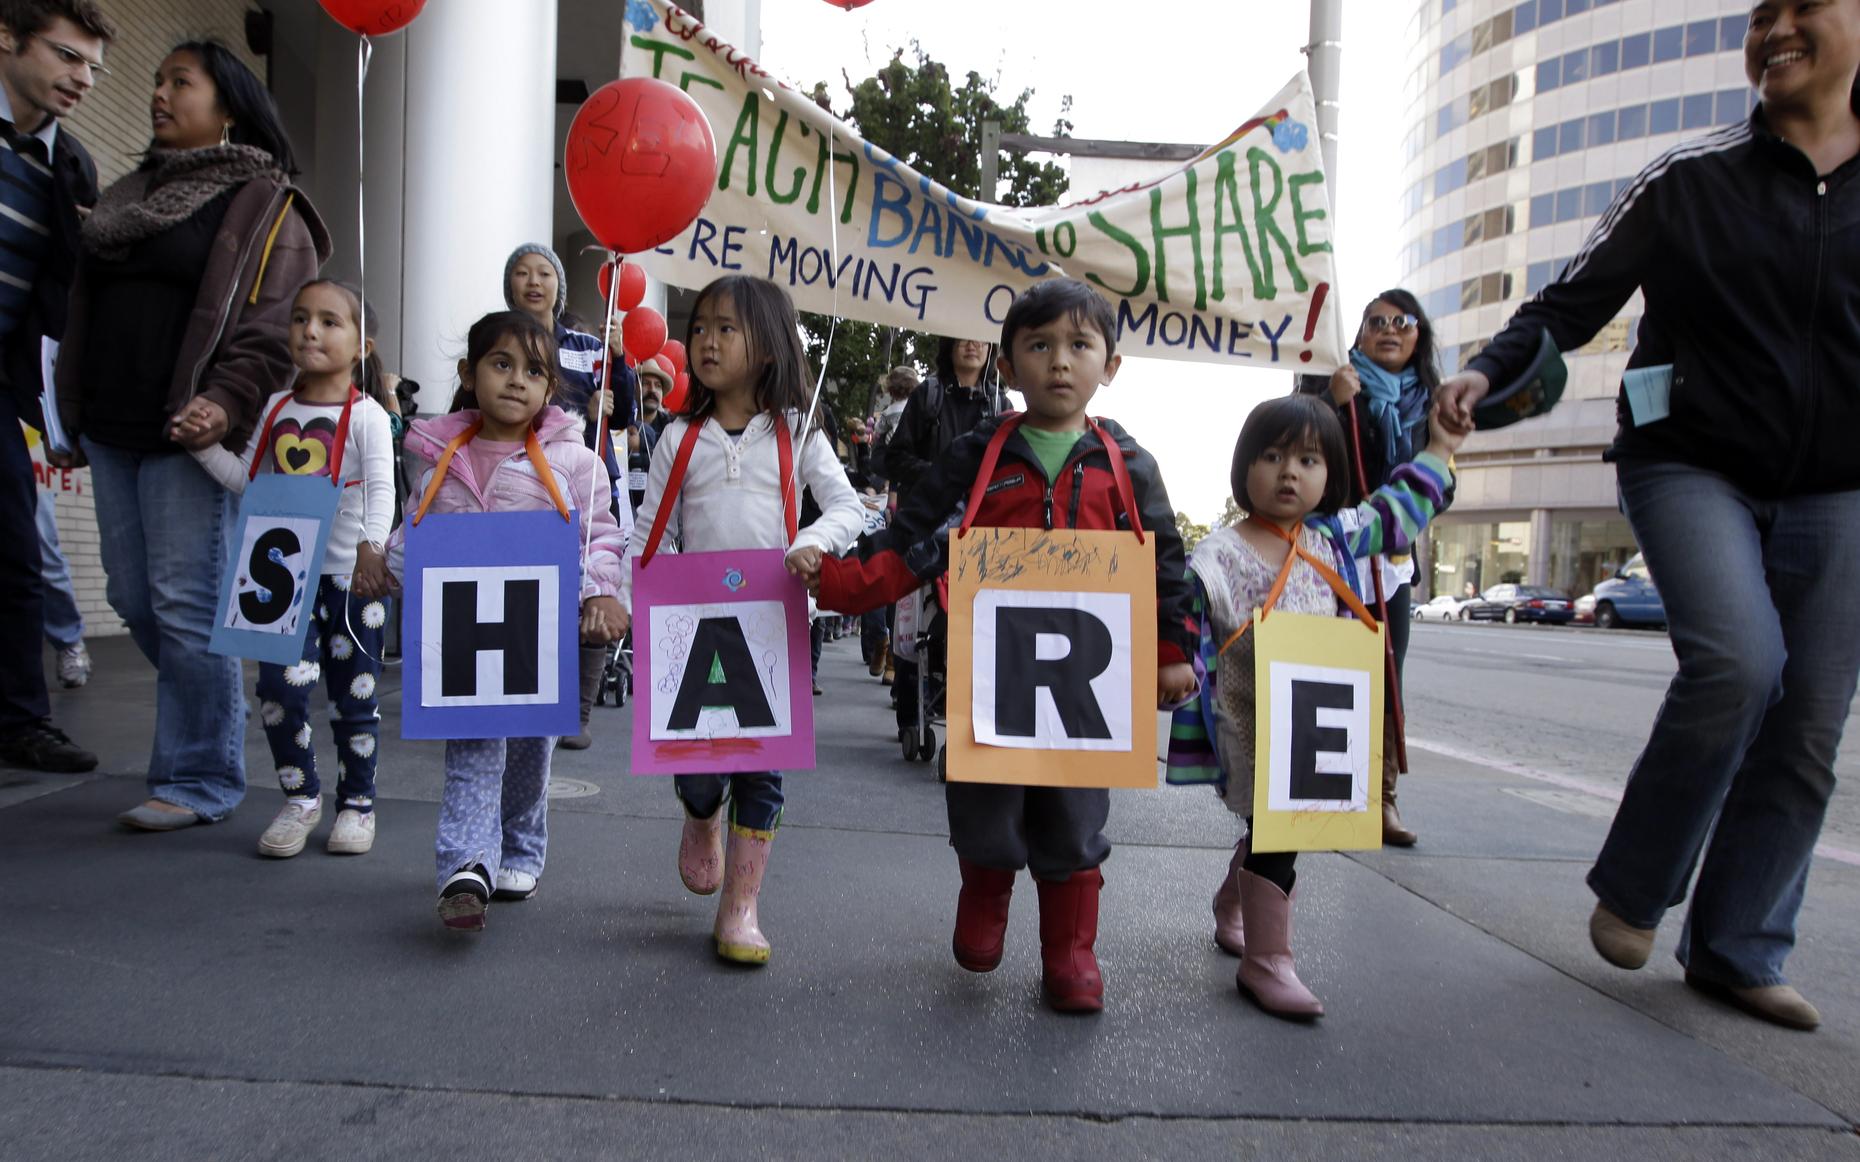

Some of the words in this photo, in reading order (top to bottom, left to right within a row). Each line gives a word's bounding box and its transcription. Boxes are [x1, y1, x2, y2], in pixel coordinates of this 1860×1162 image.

[768, 234, 939, 321] MOVING
[1084, 146, 1334, 312] SHARE
[238, 527, 302, 625] S
[441, 579, 540, 697] H
[666, 616, 777, 731] A
[994, 605, 1114, 740] R
[1288, 679, 1355, 802] E
